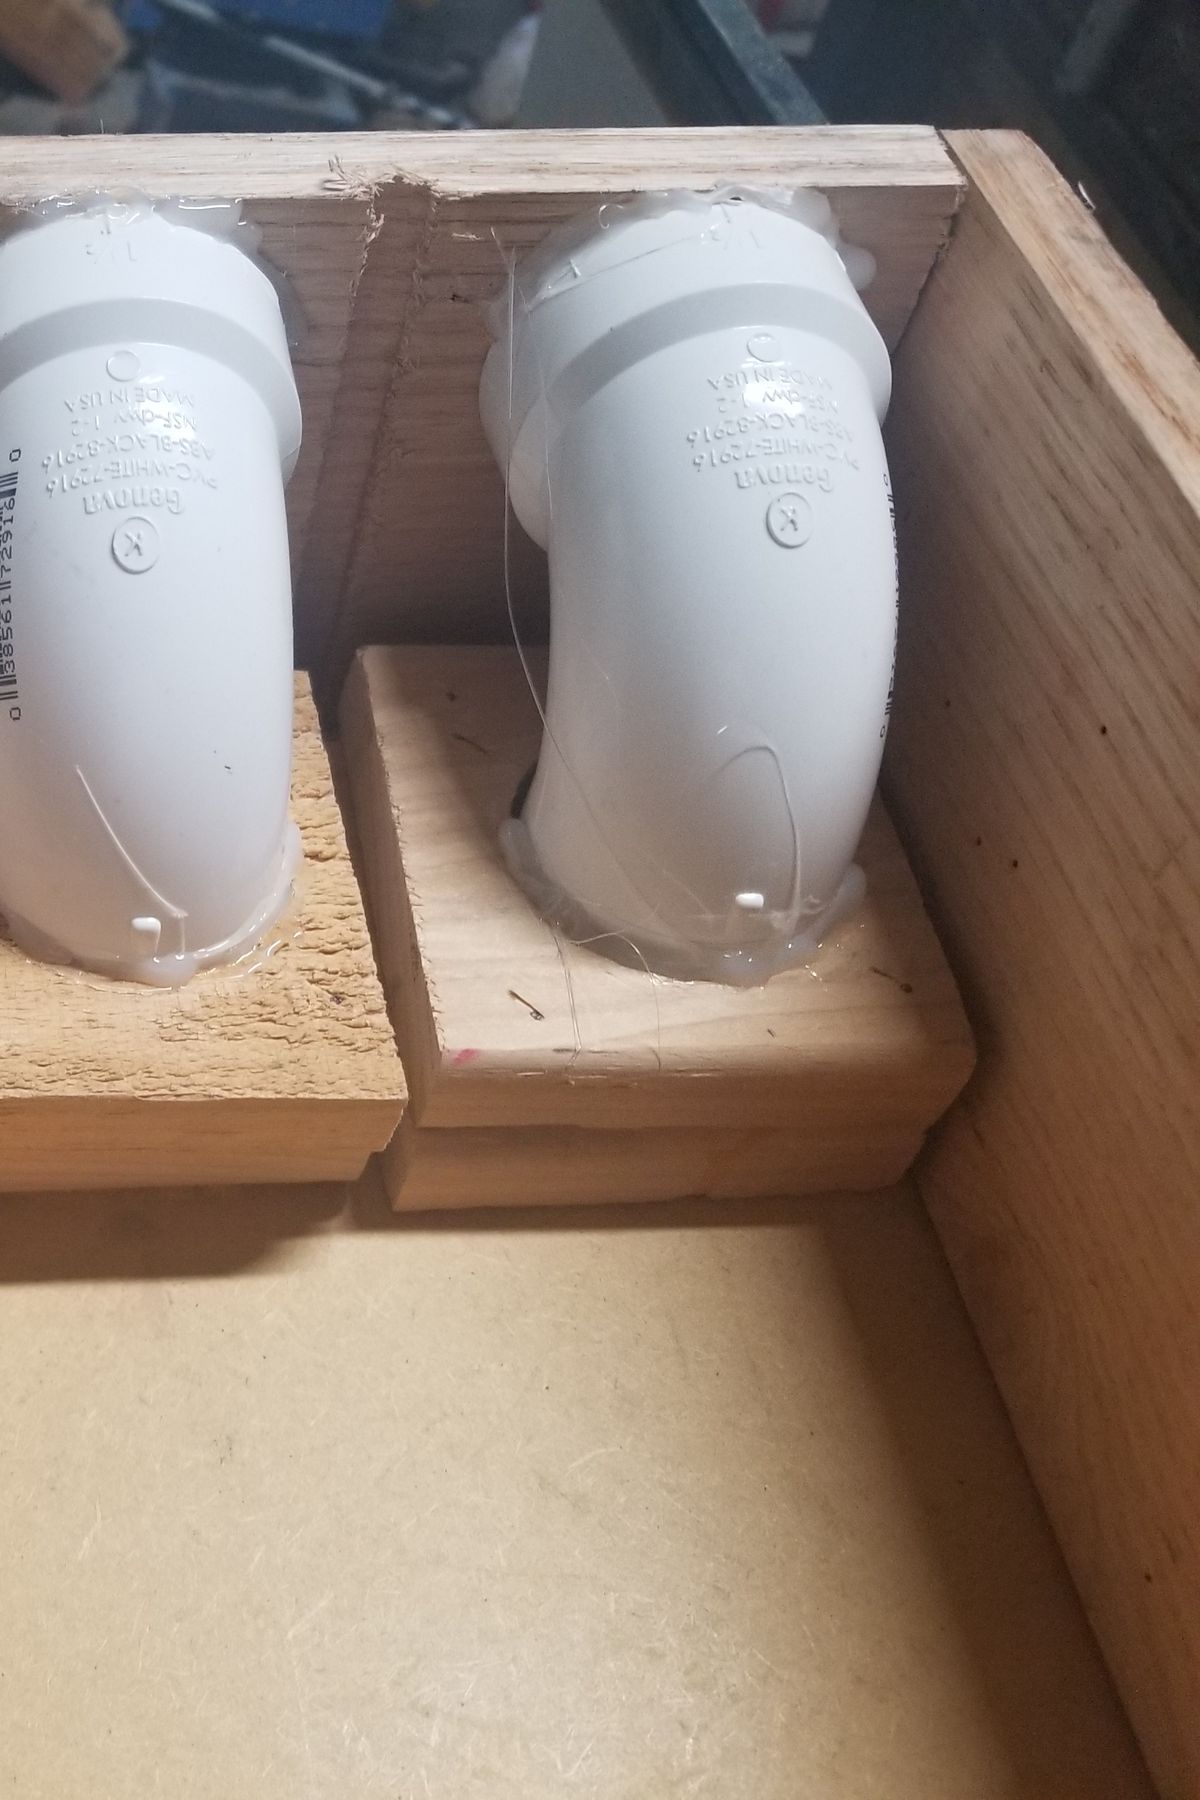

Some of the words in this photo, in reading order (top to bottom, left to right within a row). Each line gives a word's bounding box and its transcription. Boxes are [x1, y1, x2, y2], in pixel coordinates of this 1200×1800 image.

[754, 369, 774, 382] IN
[780, 368, 832, 390] MADE
[110, 390, 128, 404] IN
[134, 386, 194, 407] MADE
[734, 465, 832, 492] Genova
[83, 487, 183, 514] Genova
[0, 497, 15, 579] 72916
[0, 595, 15, 673] 38561
